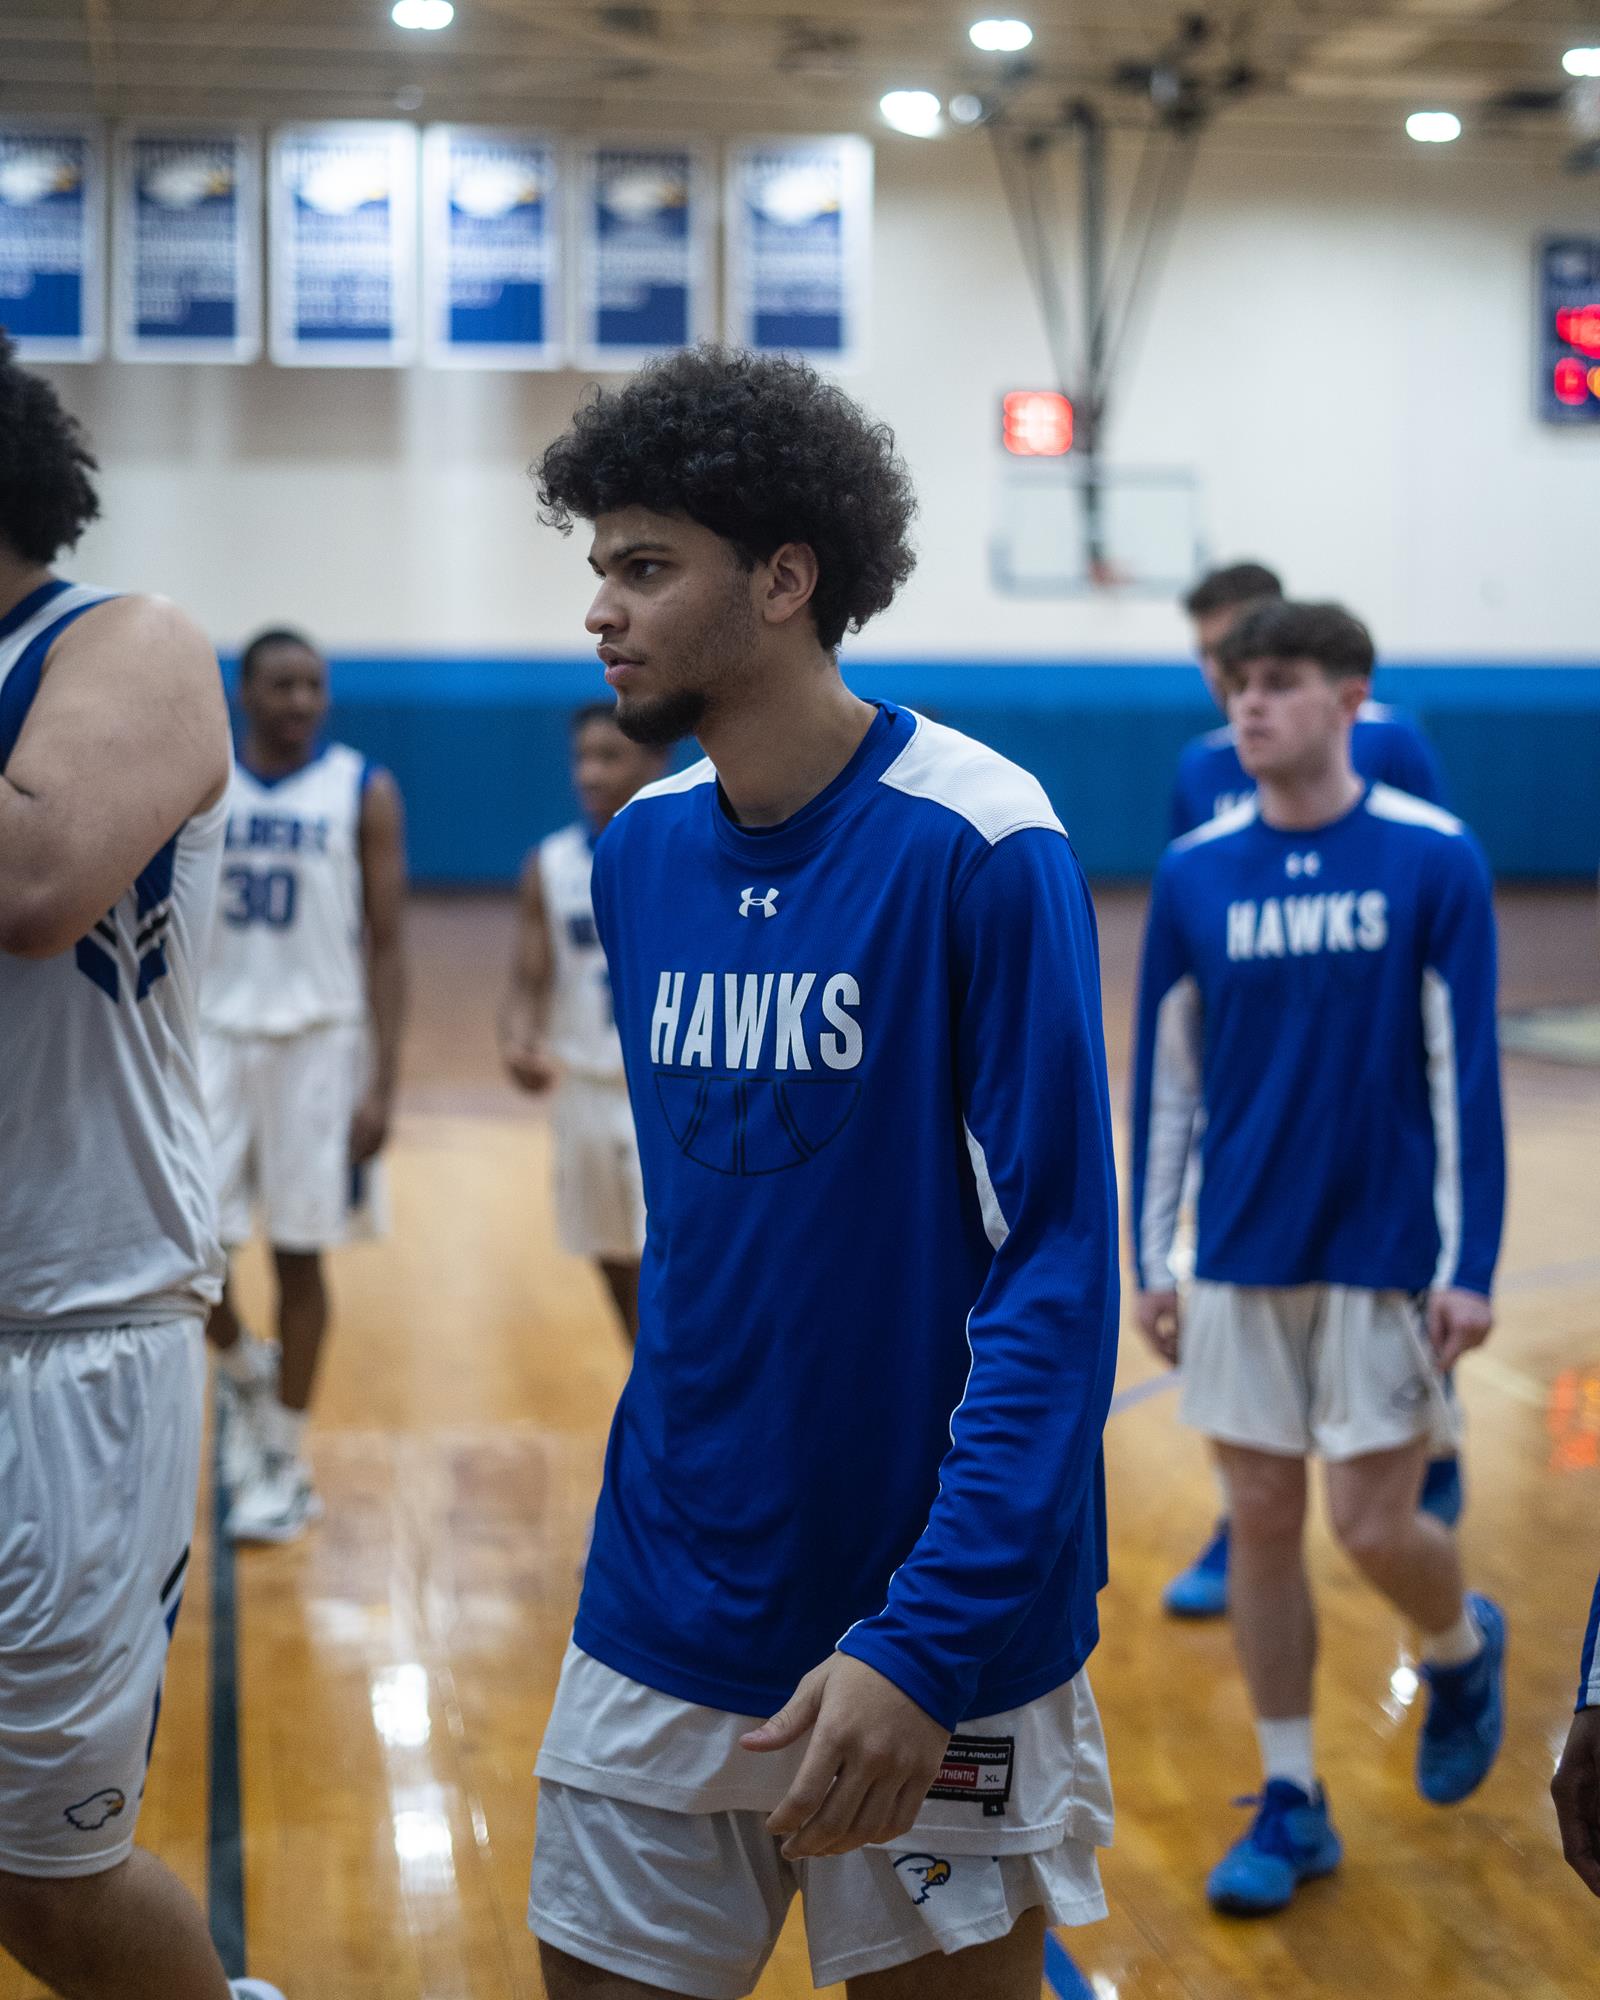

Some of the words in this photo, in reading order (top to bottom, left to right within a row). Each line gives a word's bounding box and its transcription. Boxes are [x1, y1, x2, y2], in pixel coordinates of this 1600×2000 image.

[226, 866, 297, 927] 30
[1226, 889, 1388, 962] HAWKS
[651, 971, 863, 1070] HAWKS
[945, 1750, 967, 1758] NDER
[938, 1769, 975, 1782] UTHENTIC
[984, 1774, 1000, 1783] XL
